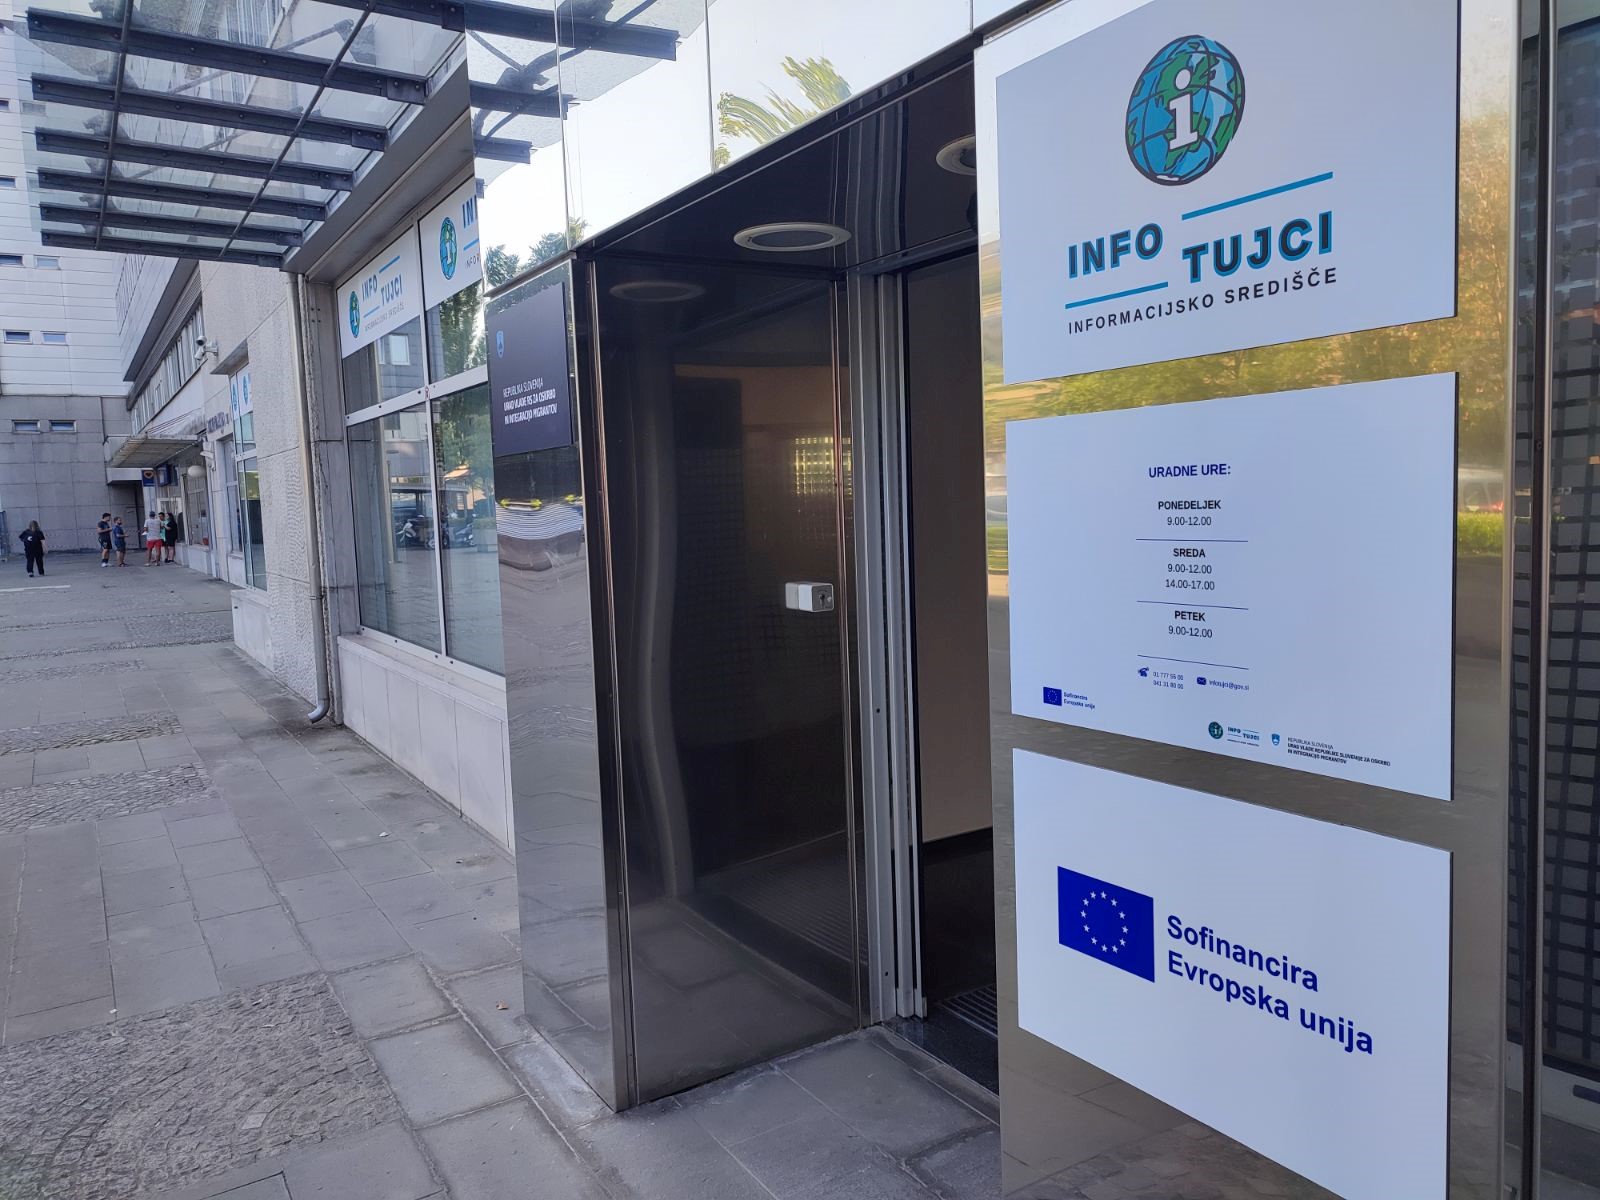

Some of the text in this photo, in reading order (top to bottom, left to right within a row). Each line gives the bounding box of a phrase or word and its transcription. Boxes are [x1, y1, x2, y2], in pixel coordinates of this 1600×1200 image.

[1068, 210, 1332, 284] INFO TUJCI
[362, 274, 403, 306] INFO TUJCI
[1068, 266, 1337, 335] INFORMACIJSKO SREDIŠČE
[1148, 464, 1231, 478] URADNE URE:
[1158, 500, 1221, 510] PONEDELJEK
[1167, 516, 1212, 526] 9.00-12.00
[1173, 548, 1206, 558] SREDA
[1168, 564, 1212, 574] 9.00-12.00
[1165, 579, 1215, 590] 14.00-17.00
[1174, 610, 1205, 622] PETEK
[1168, 625, 1213, 638] 9.00-12.00
[1167, 915, 1318, 992] Sofinancira
[1168, 950, 1372, 1054] Evropska unija
